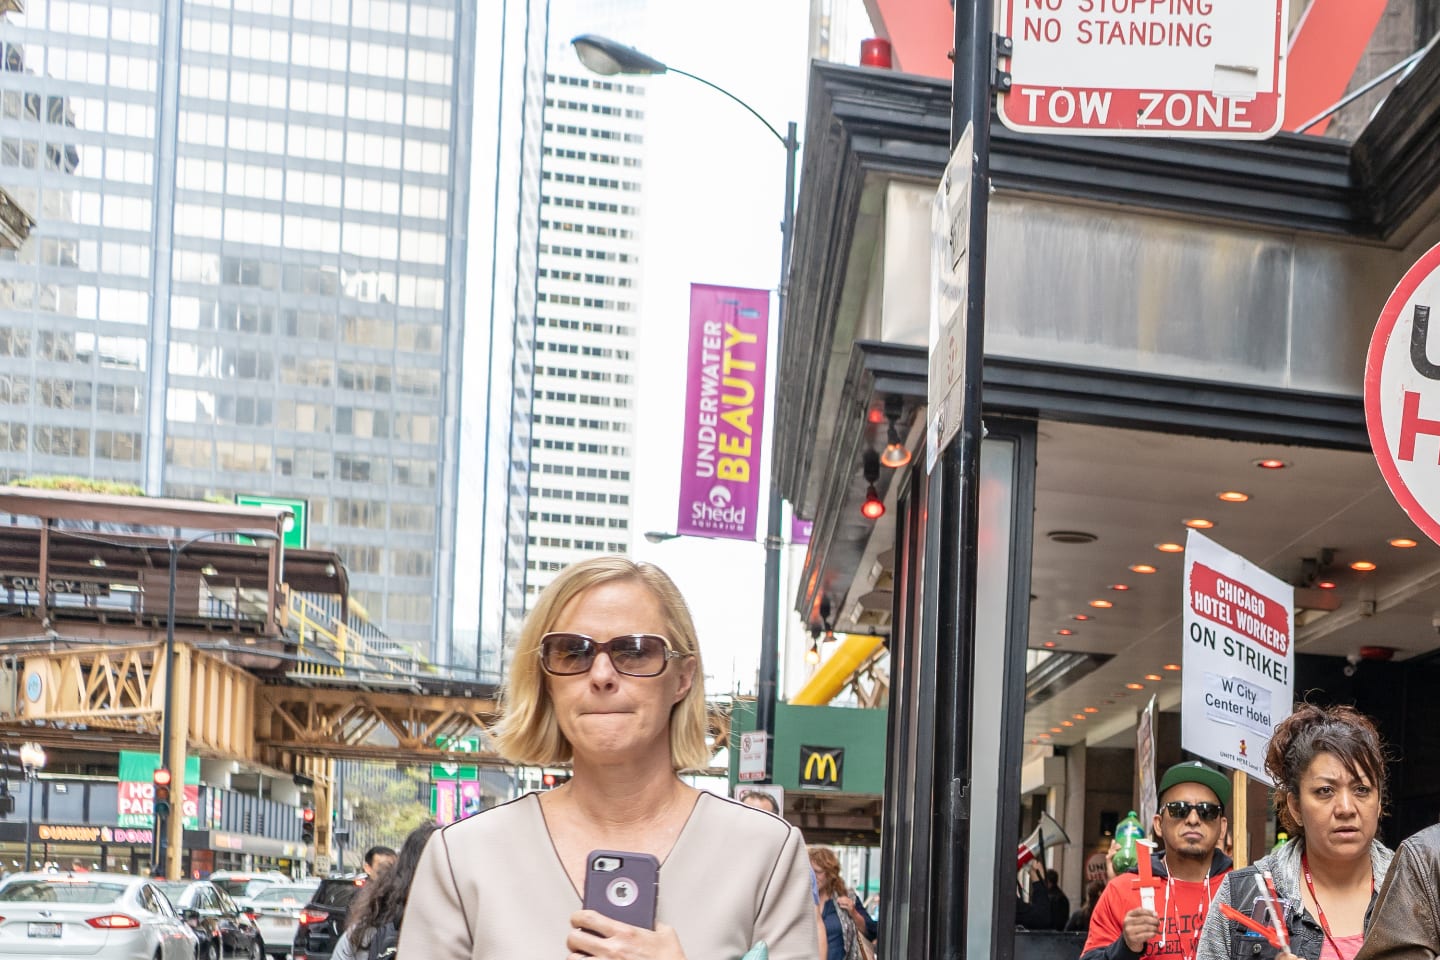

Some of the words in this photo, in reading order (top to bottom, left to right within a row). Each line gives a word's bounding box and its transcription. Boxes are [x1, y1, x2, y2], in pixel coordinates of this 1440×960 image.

[1023, 17, 1062, 42] NO
[1076, 20, 1213, 47] STANDING
[1021, 88, 1112, 125] TOW
[1137, 93, 1252, 128] ZONE
[695, 320, 722, 478] UNDERWATER
[716, 322, 758, 483] BEAUTY
[691, 501, 746, 525] Shedd
[691, 520, 744, 532] AQUARIUM
[1216, 578, 1266, 619] CHICAGO
[1194, 591, 1234, 625] HOTEL
[1236, 612, 1287, 653] WORKERS
[1190, 621, 1217, 650] ON
[1223, 636, 1288, 686] STRIKE!
[1221, 677, 1234, 694] W
[1237, 682, 1257, 705] City
[1204, 693, 1244, 718] Center
[1246, 704, 1272, 728] Hotel
[1144, 940, 1183, 956] OTEL
